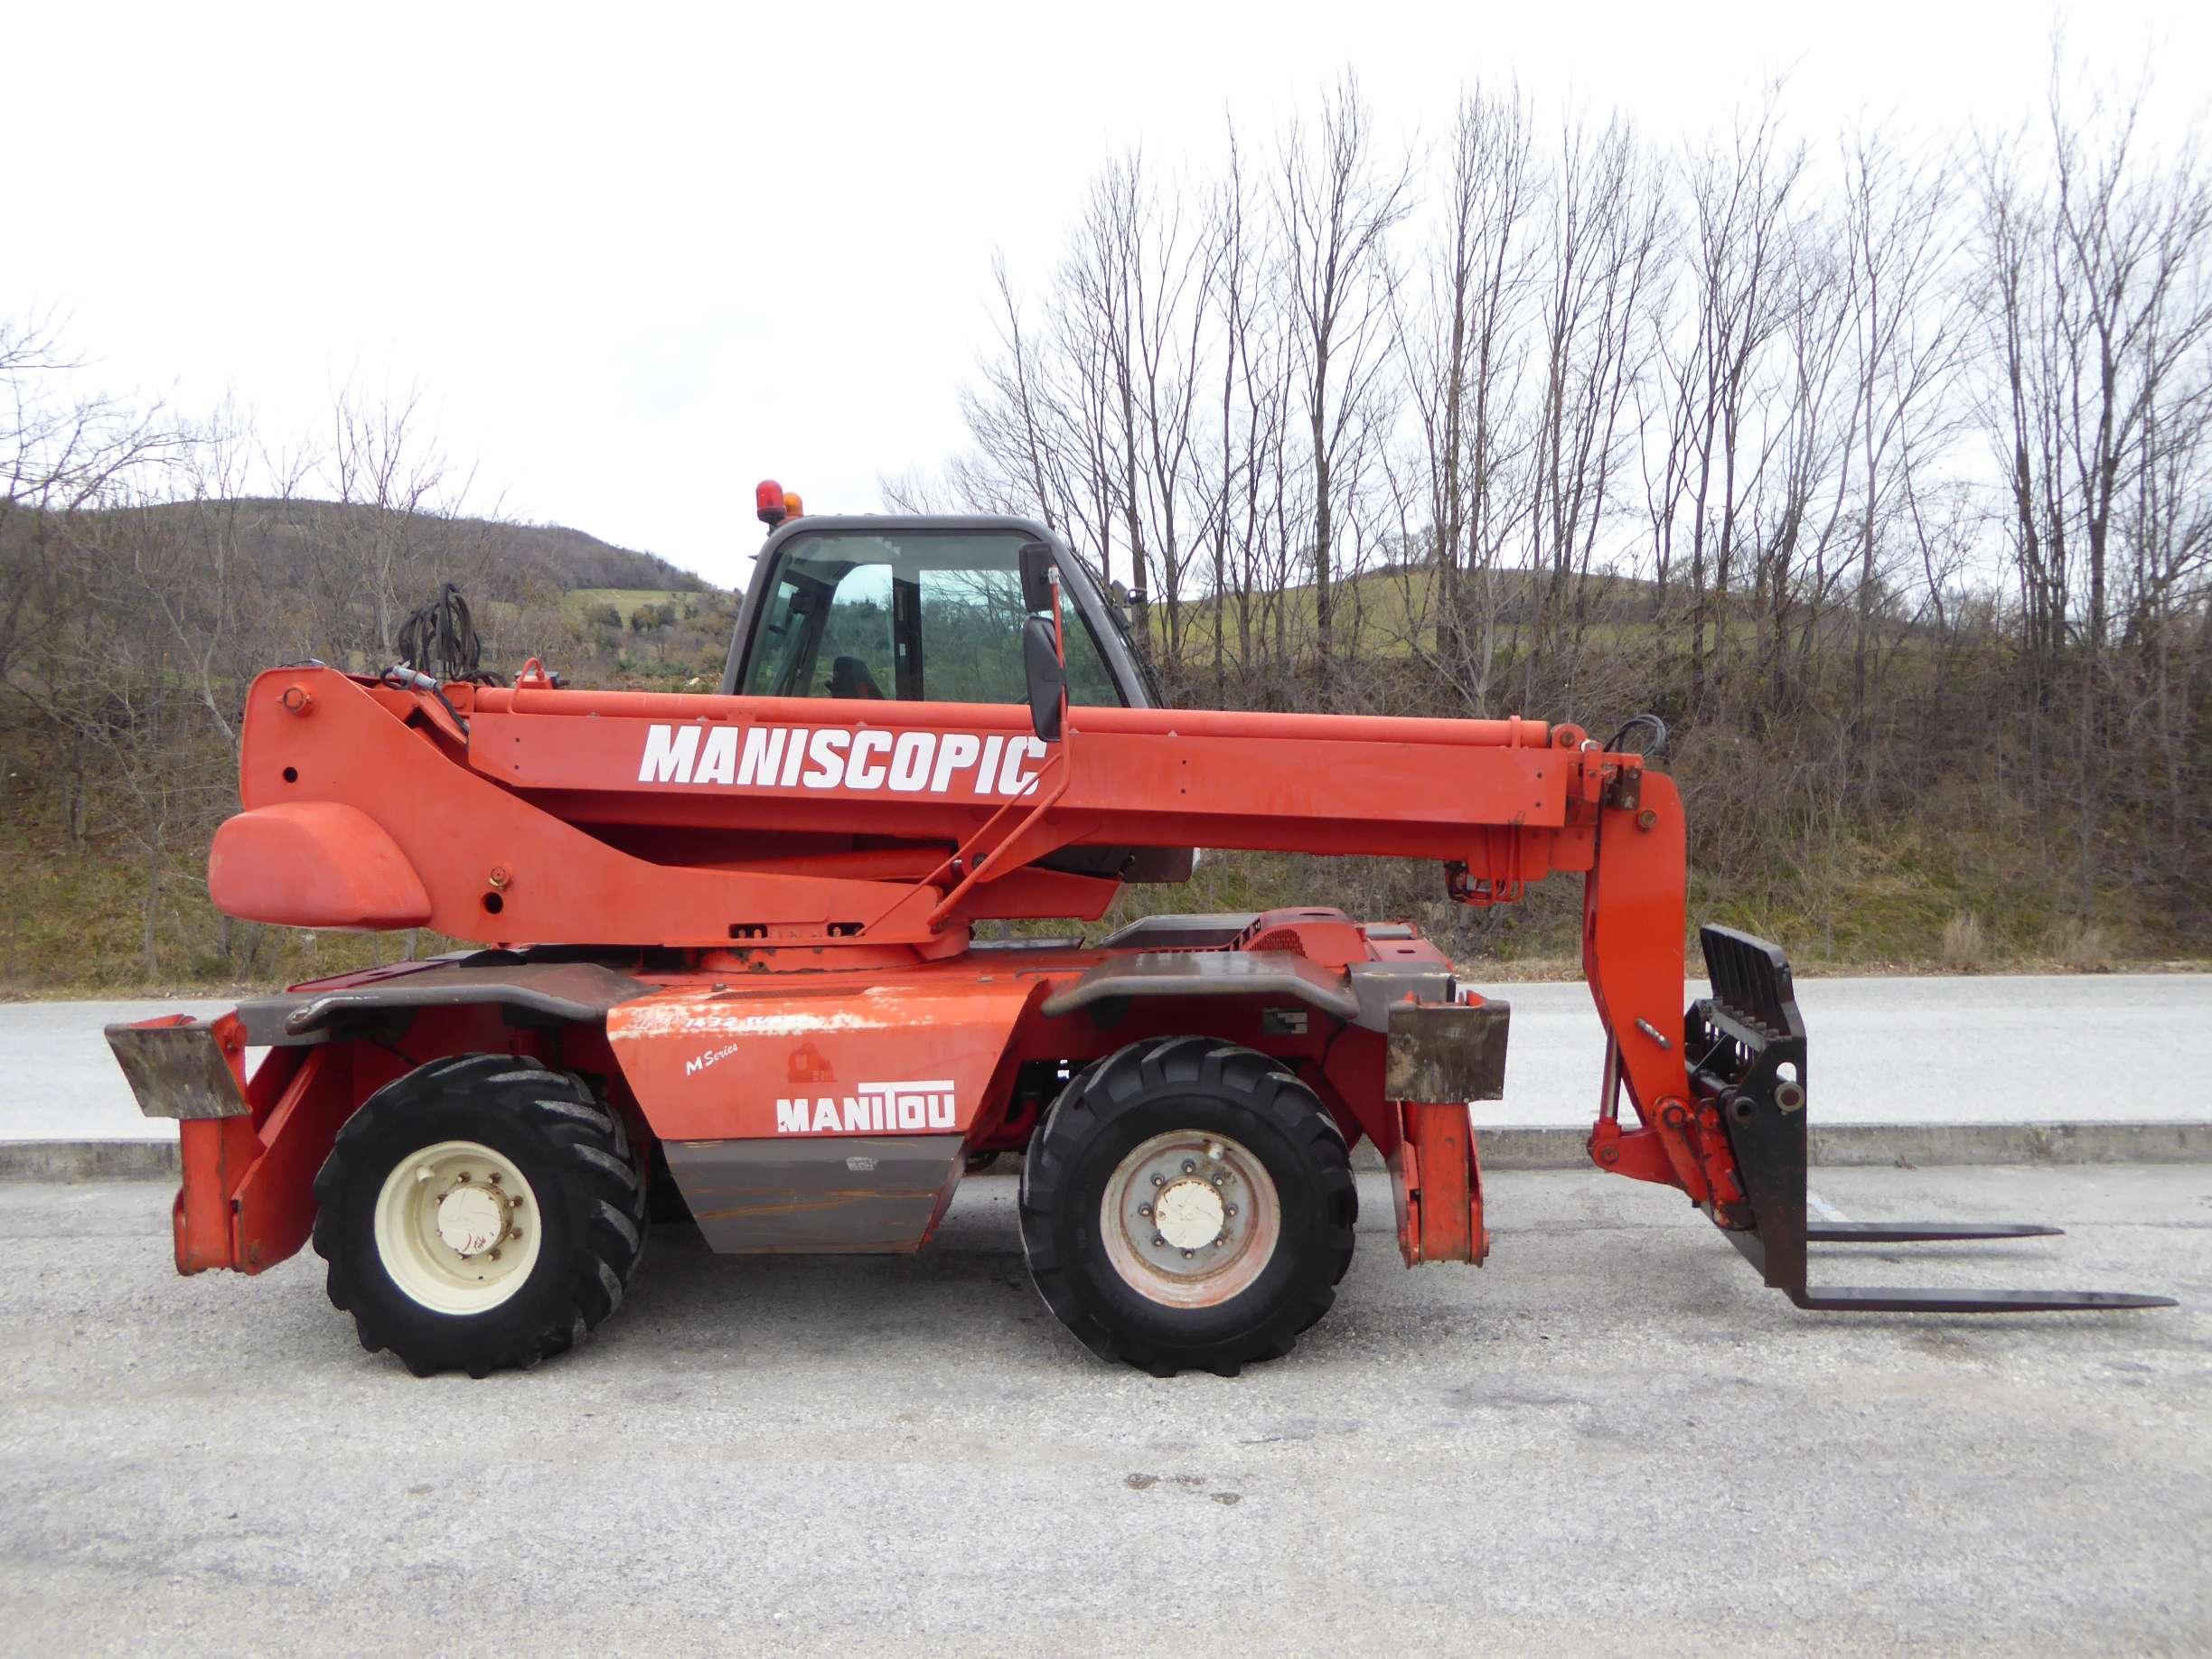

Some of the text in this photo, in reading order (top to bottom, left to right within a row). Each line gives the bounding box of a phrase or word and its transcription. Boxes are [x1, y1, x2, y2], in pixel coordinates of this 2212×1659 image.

[637, 724, 1047, 795] MANISCOPIC
[704, 1043, 738, 1066] Series
[776, 1079, 956, 1133] MANITOU
